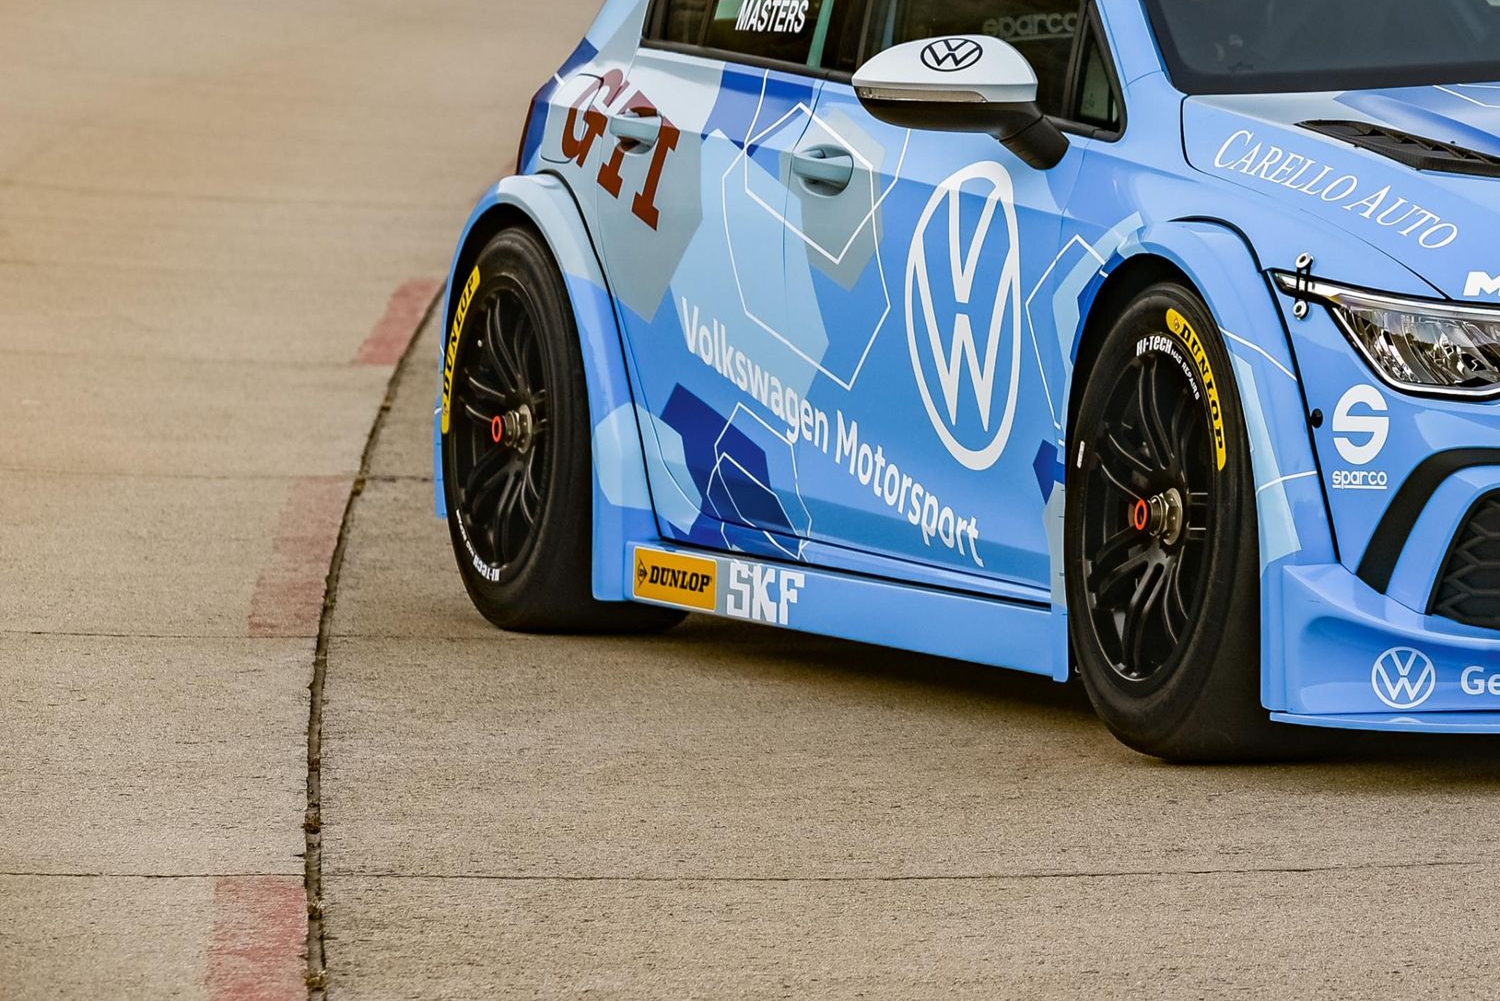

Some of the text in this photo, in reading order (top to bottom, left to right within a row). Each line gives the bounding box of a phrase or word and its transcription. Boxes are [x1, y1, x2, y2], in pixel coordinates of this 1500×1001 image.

[561, 68, 680, 231] GTI
[1213, 130, 1458, 249] CARELLO AUTO
[682, 296, 985, 568] Volkswagen Motorsport
[1180, 324, 1224, 450] DUNLOP
[1332, 470, 1388, 490] sparco
[649, 565, 711, 593] DUNLOP
[726, 561, 805, 625] SKF
